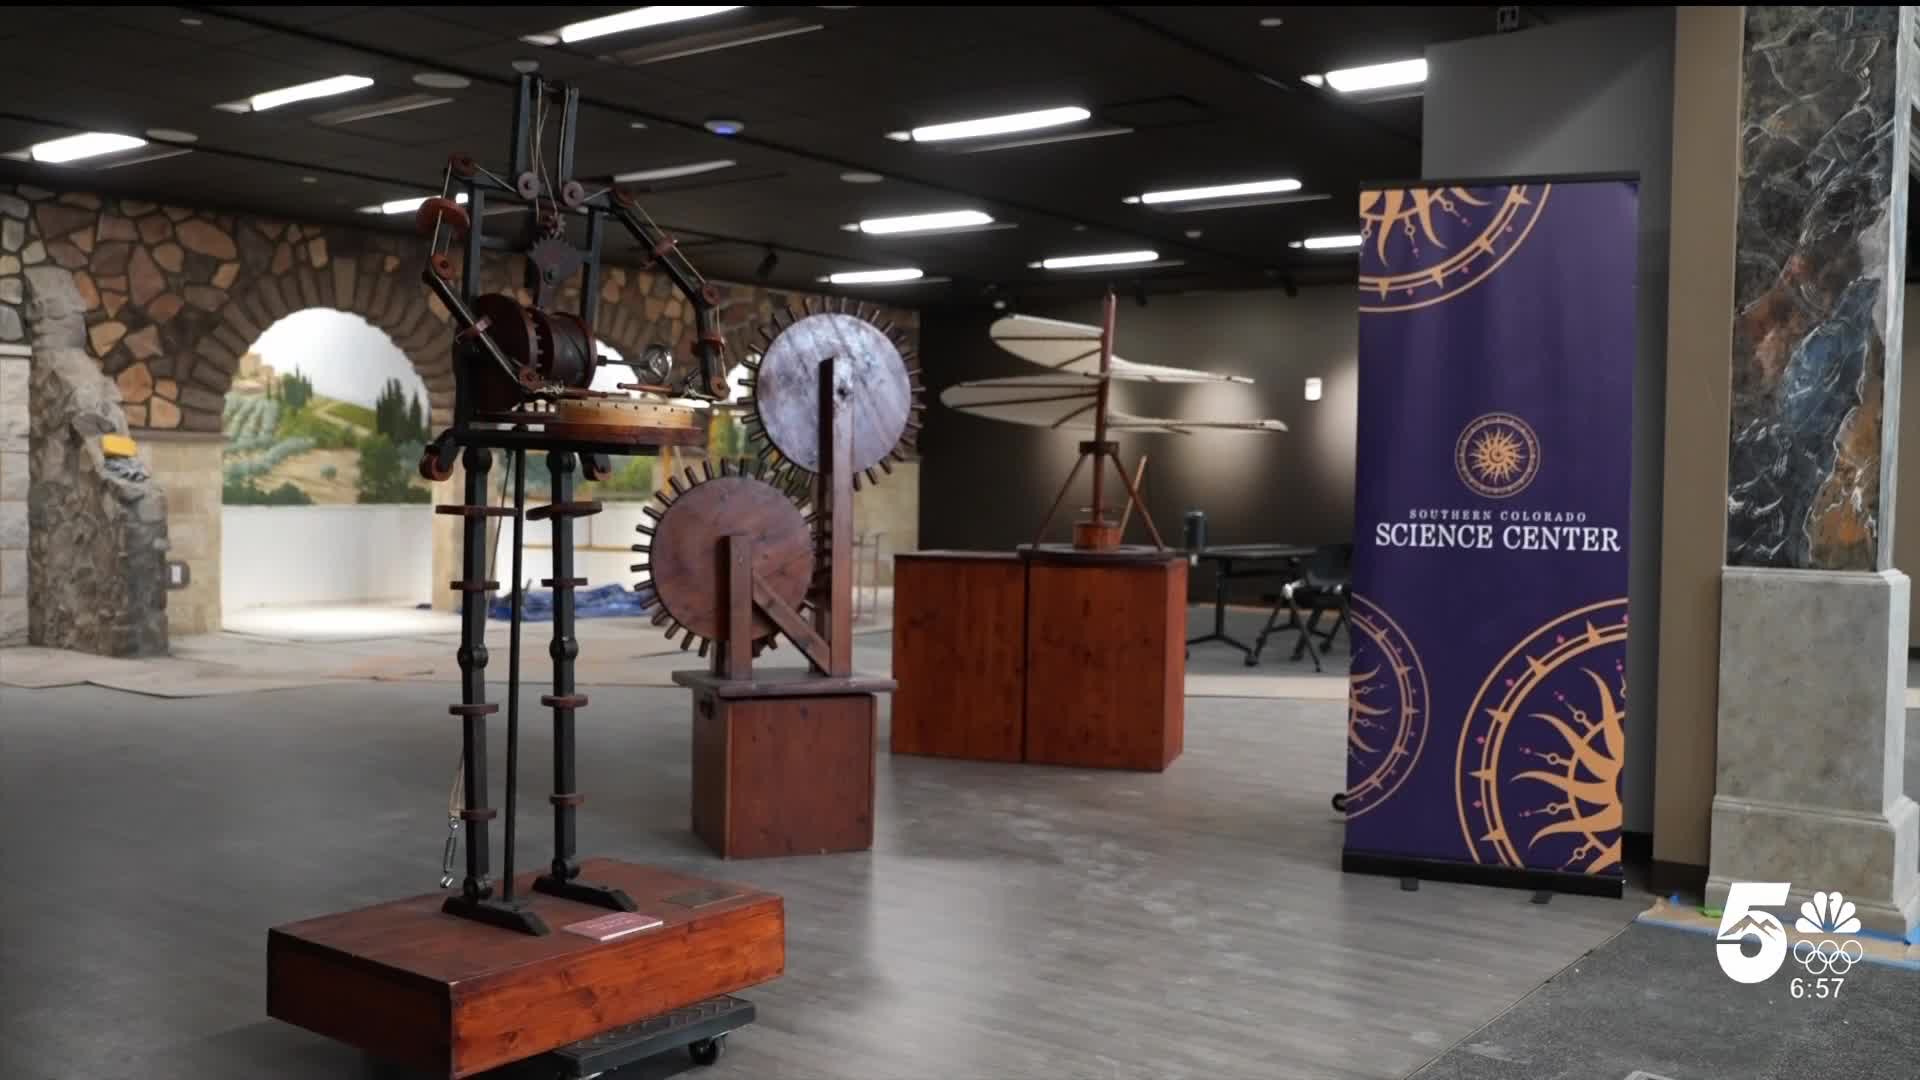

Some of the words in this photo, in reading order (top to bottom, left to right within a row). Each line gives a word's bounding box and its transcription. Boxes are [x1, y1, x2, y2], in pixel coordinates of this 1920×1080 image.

[1409, 509, 1492, 520] SOUTHERN
[1500, 511, 1586, 522] COLORADO
[1375, 523, 1493, 548] SCIENCE
[1502, 525, 1621, 551] CENTER
